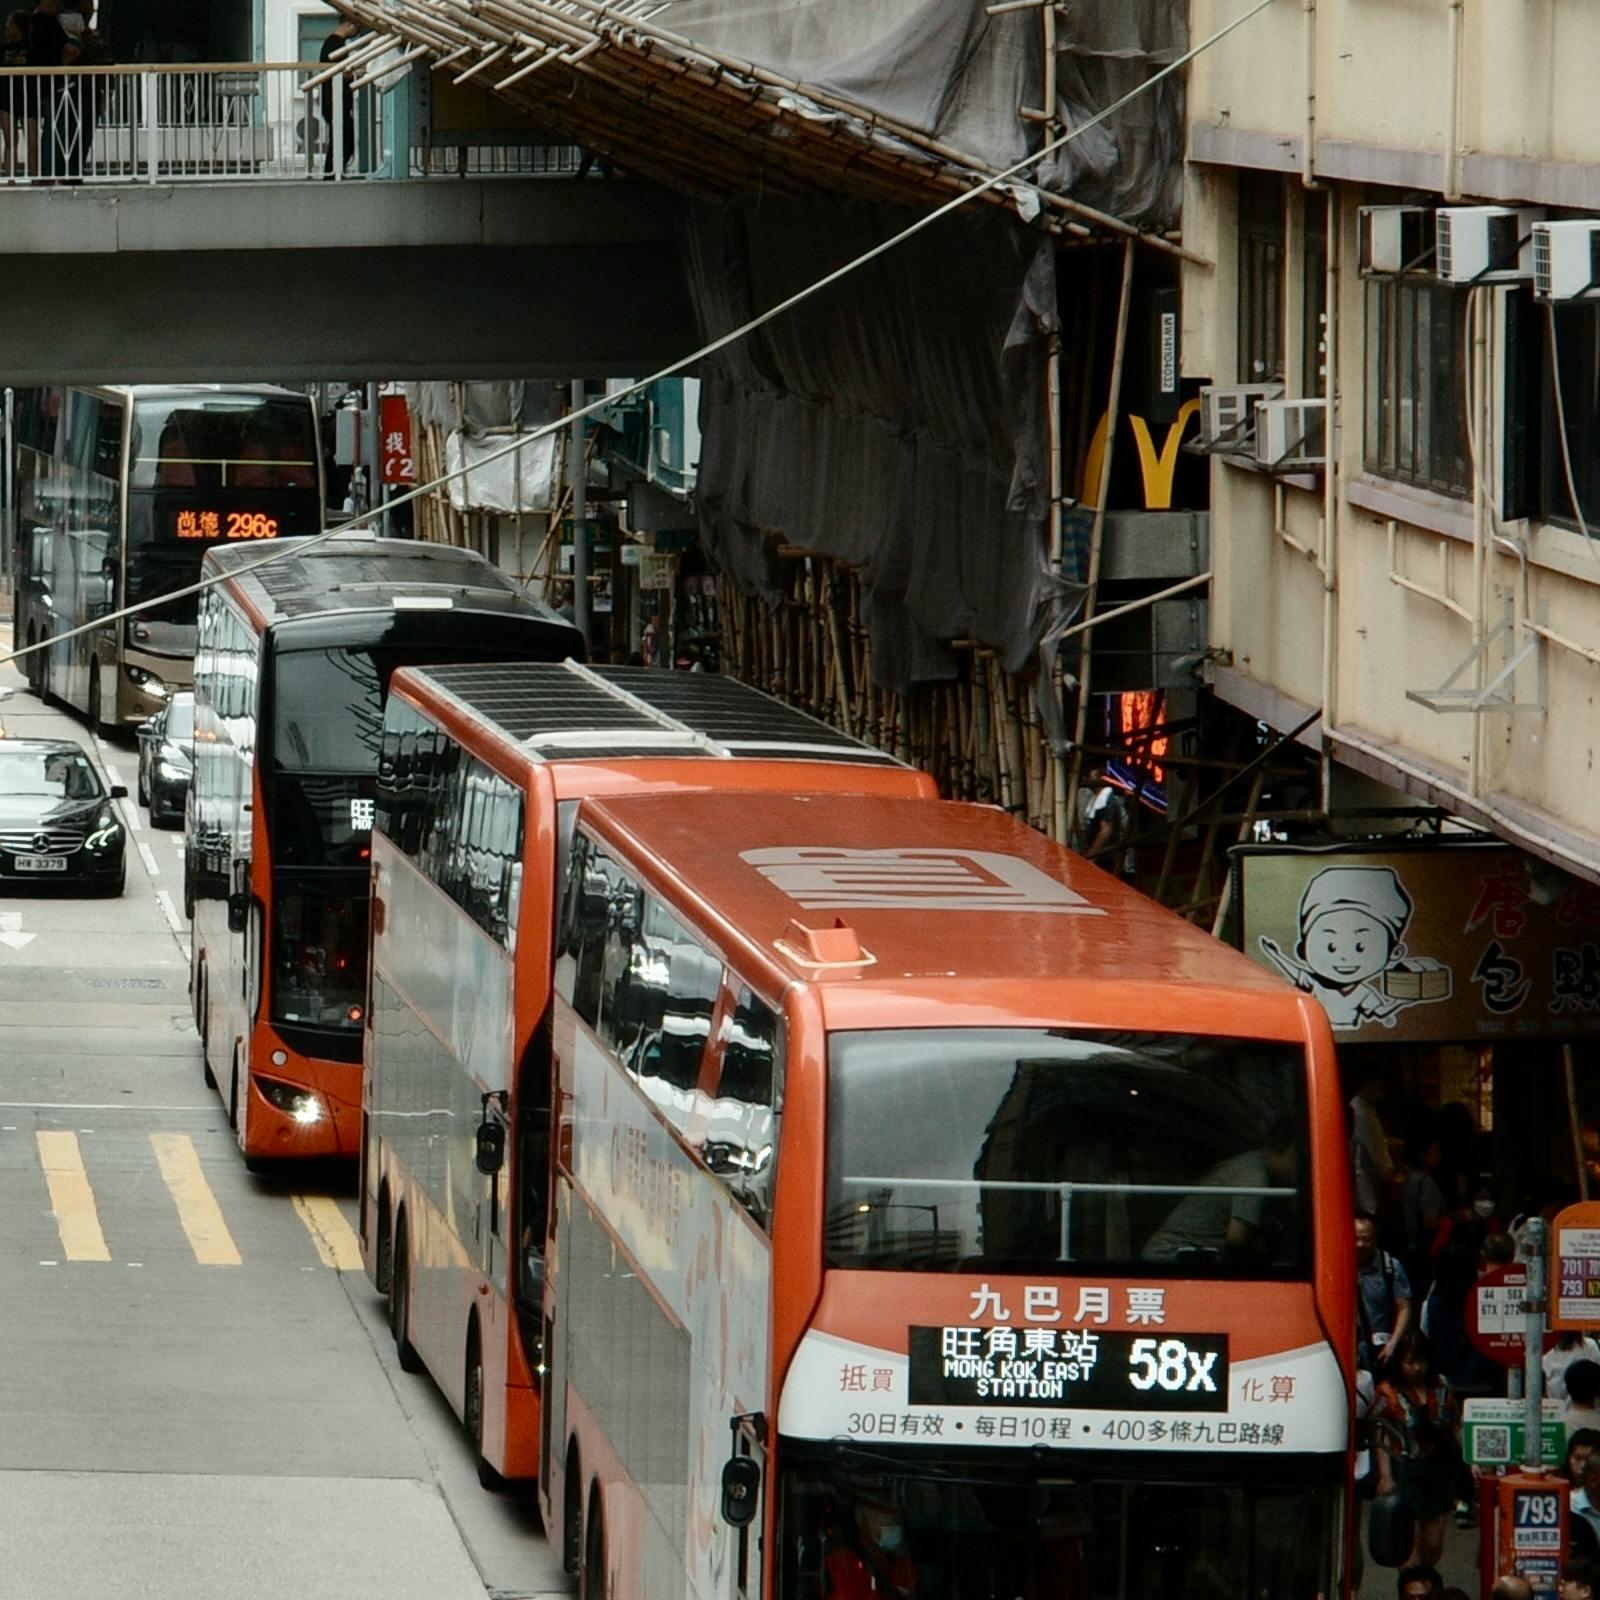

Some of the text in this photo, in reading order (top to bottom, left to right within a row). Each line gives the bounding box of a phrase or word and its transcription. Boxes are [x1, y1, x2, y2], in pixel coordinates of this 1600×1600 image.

[969, 1283, 1166, 1325] 九巴月票
[942, 1326, 1100, 1363] 旺角東站
[943, 1358, 1095, 1382] MONG KOK EAST
[976, 1378, 1064, 1399] STATION
[1241, 1375, 1297, 1403] 化算
[1517, 1495, 1558, 1525] 793
